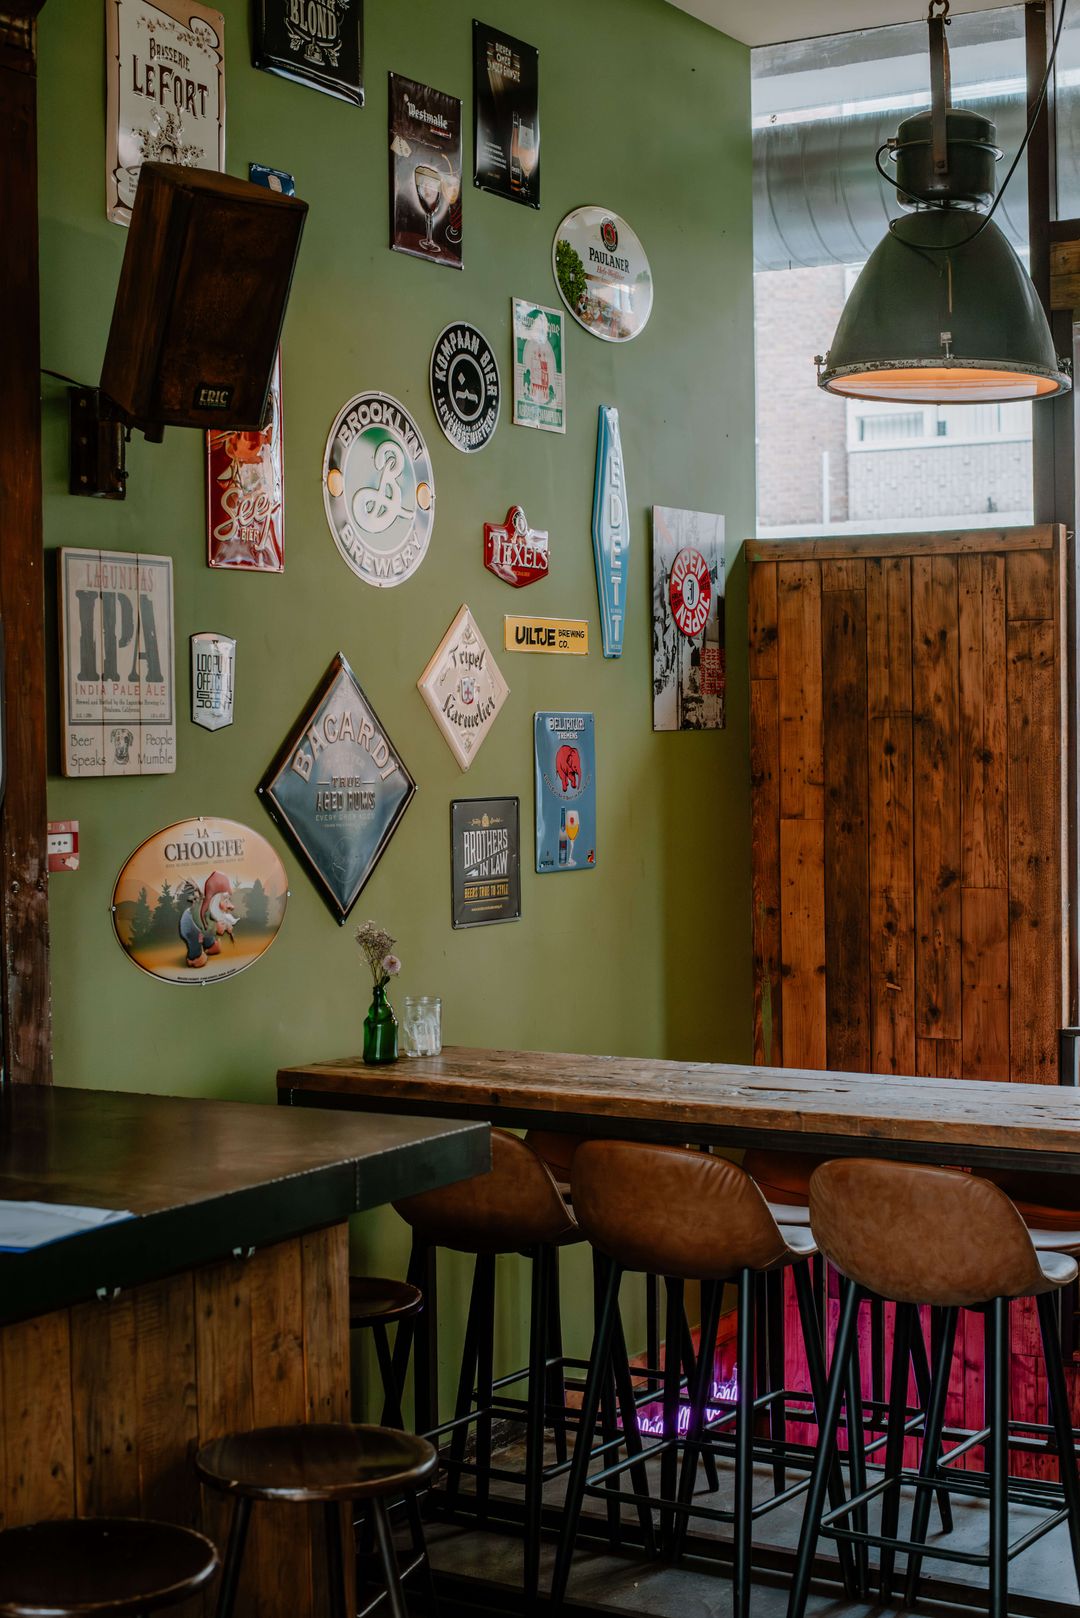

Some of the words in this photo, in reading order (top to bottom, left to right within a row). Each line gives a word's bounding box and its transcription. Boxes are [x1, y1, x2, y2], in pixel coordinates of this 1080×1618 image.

[290, 0, 338, 40] BLOND
[149, 37, 191, 72] BRASSERIE
[407, 101, 449, 129] Westmalle
[588, 246, 630, 274] PAULANER
[435, 329, 480, 382] KOMPAAN
[481, 350, 498, 397] BIER
[199, 389, 229, 404] ERIC
[337, 400, 424, 460] BROOKLYN
[606, 413, 623, 642] VEDETT
[338, 522, 422, 578] BREWERY
[489, 529, 549, 570] TEXELS
[86, 563, 155, 592] LAGUNITAS
[672, 549, 706, 591] JOPEN
[674, 592, 710, 634] JOPEN
[75, 589, 164, 683] IPA
[515, 625, 556, 647] UILTJE
[558, 629, 585, 639] BREWING
[558, 640, 570, 649] CO.
[449, 644, 486, 671] Tripel
[75, 682, 106, 696] INDIA
[112, 682, 141, 696] PALE
[146, 683, 166, 696] ALE
[549, 717, 585, 731] DELIRIUM
[557, 732, 578, 740] TREMENS
[70, 734, 95, 747] Beer
[145, 728, 173, 750] People
[70, 749, 107, 774] Speaks
[138, 749, 173, 765] Mumble
[331, 777, 361, 789] TRUE
[315, 791, 345, 812] AGED
[346, 790, 376, 811] RUMS
[197, 828, 209, 839] LA
[164, 839, 244, 861] CHOUFFE
[463, 829, 508, 869] BROTHERS
[480, 862, 489, 876] IN
[490, 850, 508, 875] LAW
